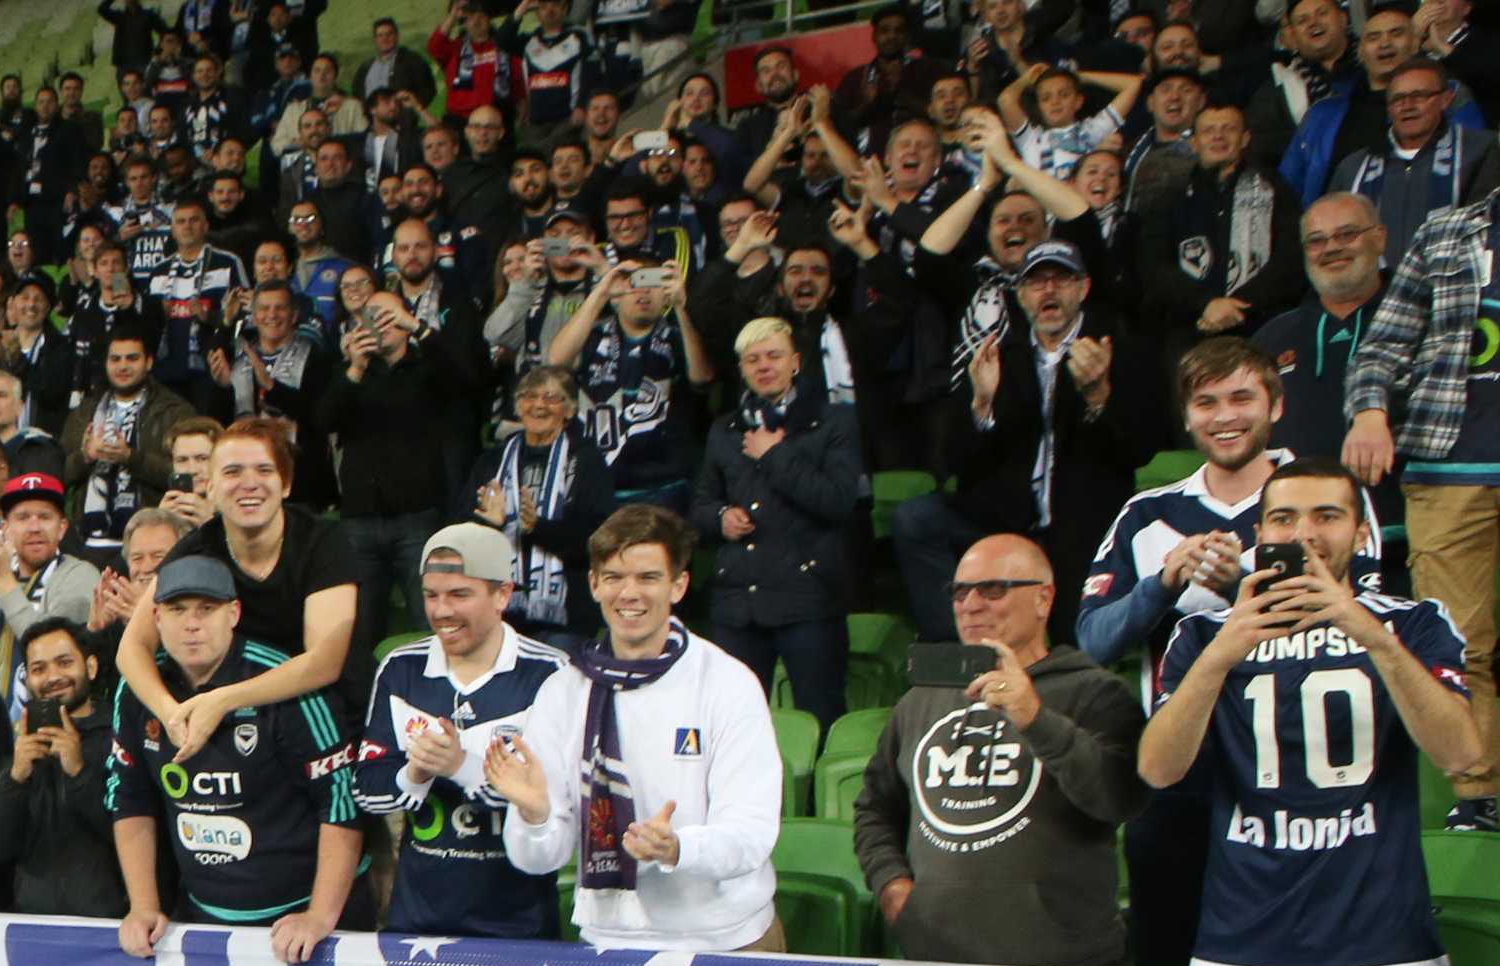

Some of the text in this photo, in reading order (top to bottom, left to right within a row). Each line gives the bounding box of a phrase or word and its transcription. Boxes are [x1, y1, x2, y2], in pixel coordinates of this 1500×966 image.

[1243, 668, 1376, 789] 10
[192, 771, 243, 795] CTI
[941, 796, 996, 810] TRAINING
[919, 821, 958, 852] MOTIVATE
[972, 817, 1030, 852] EMPOWER
[1227, 803, 1266, 848] La
